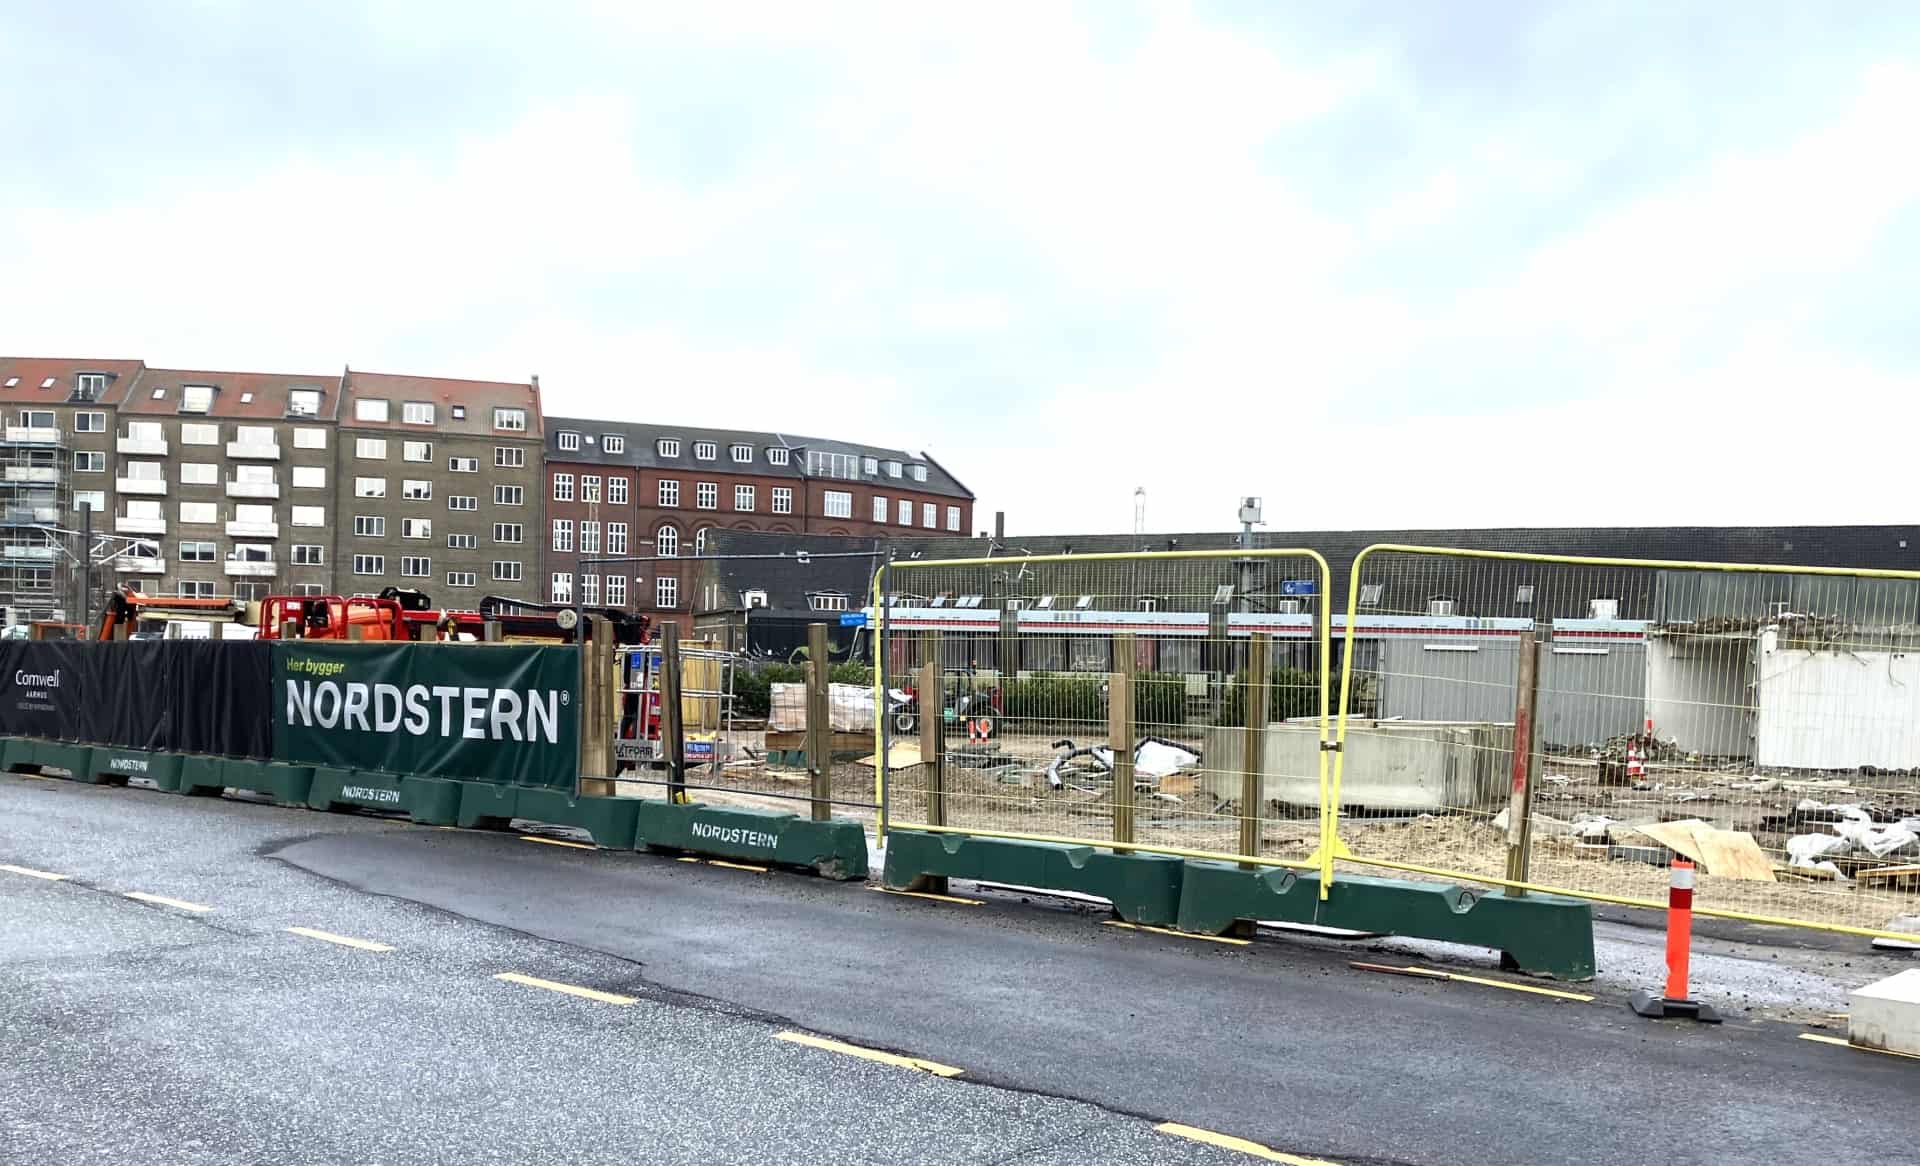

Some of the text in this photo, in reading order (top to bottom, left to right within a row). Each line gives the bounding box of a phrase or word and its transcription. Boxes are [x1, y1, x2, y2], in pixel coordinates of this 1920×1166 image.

[287, 657, 345, 676] Her bygger
[110, 758, 149, 772] NORDSTERN
[342, 785, 400, 803] NORDSTERN
[692, 822, 778, 849] NORDSTERN
